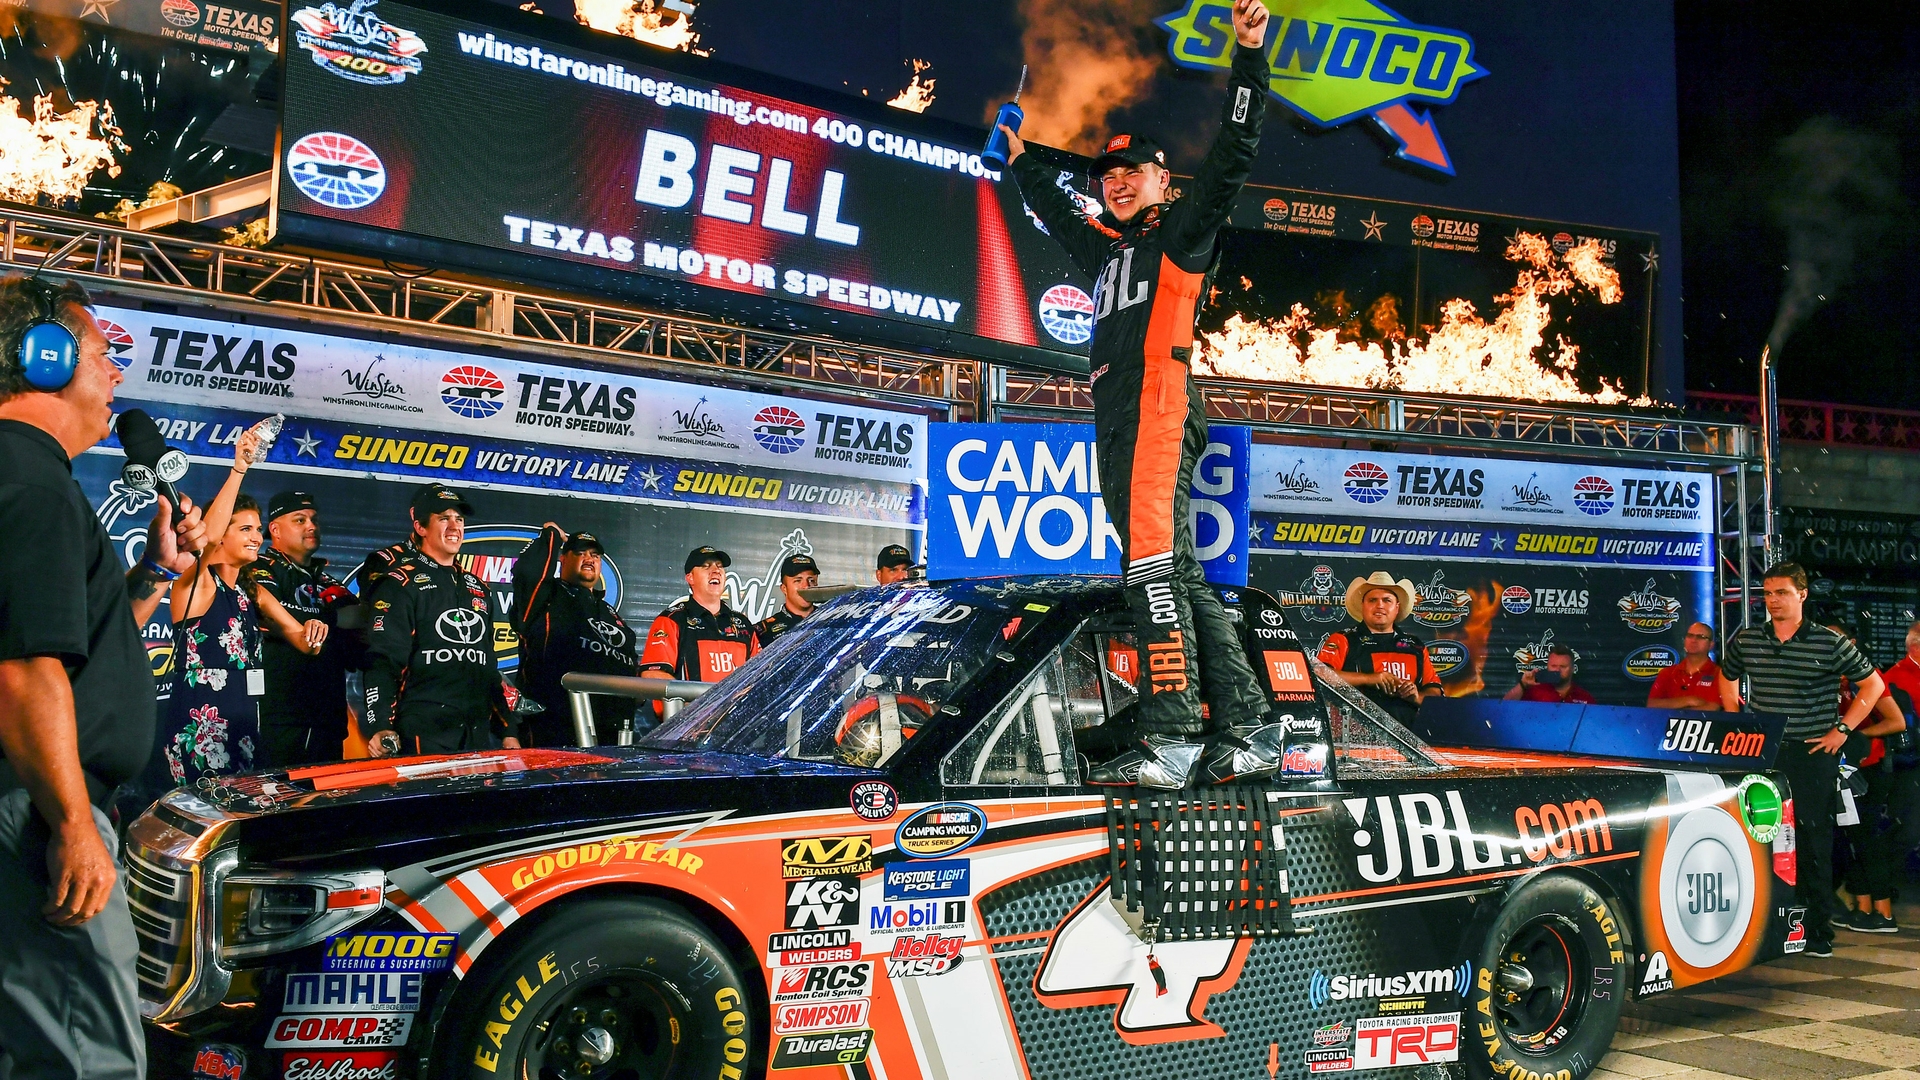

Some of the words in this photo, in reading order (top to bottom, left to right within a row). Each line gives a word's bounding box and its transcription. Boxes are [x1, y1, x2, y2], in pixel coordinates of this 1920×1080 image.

[204, 24, 230, 35] MOTOR
[205, 4, 274, 35] TEXAS
[161, 27, 173, 38] The
[174, 29, 197, 43] Great
[334, 55, 386, 74] 400
[458, 31, 807, 128] winstaronlinegaming.com
[813, 117, 863, 148] 400
[634, 128, 860, 246] BELL
[1291, 202, 1336, 220] TEXAS
[1273, 223, 1287, 231] Great
[1309, 218, 1333, 226] SPEEDWAY
[1437, 219, 1479, 236] TEXAS
[503, 214, 634, 263] TEXAS
[644, 242, 776, 290] MOTOR
[783, 269, 961, 324] SPEEDWAY
[149, 326, 297, 380] TEXAS
[147, 369, 204, 388] MOTOR
[208, 374, 290, 397] SPEEDWAY
[342, 360, 406, 397] WinStar
[516, 373, 637, 421] TEXAS
[515, 411, 563, 428] MOTOR
[565, 417, 631, 436] SPEEDWAY
[672, 402, 725, 437] WinStar
[815, 413, 914, 454] TEXAS
[161, 455, 182, 474] FOX
[335, 433, 469, 470] SUNOCO
[475, 451, 570, 479] VICTORY
[570, 460, 629, 484] LANE
[815, 447, 852, 462] MOTOR
[855, 450, 909, 468] SPEEDWAY
[127, 469, 149, 481] FOX
[1276, 463, 1320, 492] WinStar
[1397, 465, 1484, 498] TEXAS
[674, 470, 783, 501] SUNOCO
[787, 483, 864, 506] VICTORY
[865, 493, 912, 512] LANE
[1512, 477, 1552, 504] WinStar
[1622, 479, 1700, 508] TEXAS
[1397, 495, 1430, 506] MOTOR
[1432, 497, 1480, 509] SPEEDWAY
[1622, 508, 1652, 518] MOTOR
[1655, 509, 1698, 519] SPEEDWAY
[1273, 521, 1365, 544] SUNOCO
[1370, 528, 1438, 546] VICTORY
[1439, 531, 1481, 548] LANE
[1515, 532, 1598, 555] SUNOCO
[1603, 538, 1665, 556] VICTORY
[1665, 541, 1702, 557] LANE
[1281, 592, 1300, 606] NO
[1416, 584, 1455, 605] WinStar
[1534, 588, 1589, 608] TEXAS
[1633, 591, 1666, 611] WinStar
[1424, 613, 1451, 621] 400
[1638, 619, 1662, 627] 400
[1144, 581, 1190, 696] JBL.com
[1255, 628, 1299, 641] TOYOTA
[579, 636, 635, 666] TOYOTA
[1274, 662, 1303, 680] JBL
[1278, 693, 1315, 701] HARMAN
[1279, 714, 1322, 738] Rowdy
[1662, 719, 1765, 757] JBL.com
[1282, 751, 1323, 773] KBM
[855, 781, 889, 798] NASCAR
[857, 803, 894, 818] SALUTES
[938, 812, 970, 823] NASCAR
[904, 825, 946, 837] CAMPING
[946, 823, 977, 835] WORLD
[1342, 790, 1613, 882] JBL.com
[1747, 821, 1782, 843] ETHANOL
[783, 864, 839, 877] MECHANIX
[840, 860, 872, 873] WEAR
[888, 870, 935, 886] KEYSTONE
[936, 868, 967, 883] LIGHT
[904, 881, 952, 892] POLE
[1686, 872, 1730, 915] JBL
[790, 905, 840, 927] N
[870, 902, 937, 929] Mobil
[950, 903, 958, 923] 1
[1035, 806, 1253, 1045] 4
[931, 923, 965, 931] LUBRICANTS
[1584, 895, 1624, 964] EAGLE
[327, 935, 456, 958] MOOG
[773, 932, 846, 949] LINCOLN
[894, 934, 963, 958] Holley
[331, 959, 376, 969] STEERING
[380, 959, 385, 969] &
[390, 959, 448, 969] SUSPENSION
[788, 949, 853, 964] WELDERS
[888, 957, 953, 977] MSD
[804, 964, 869, 991] RCS
[1639, 980, 1673, 996] AXALTA
[286, 975, 420, 1004] MAHLE
[775, 992, 810, 1002] Renton
[812, 990, 830, 999] Coil
[832, 988, 863, 998] Spring
[474, 951, 560, 1073] EAGLE
[782, 1003, 862, 1028] SIMPSON
[1379, 1001, 1426, 1011] SCHROTH
[274, 1018, 377, 1041] COMP
[1359, 1020, 1384, 1028] TOYOTA
[1387, 1018, 1411, 1026] RACING
[1414, 1014, 1459, 1024] DEVELOPMENT
[343, 1035, 393, 1045] CAMS
[1314, 1027, 1351, 1037] INTERSTATE
[786, 1033, 866, 1055] Duralast
[1358, 1024, 1458, 1065] TRD
[193, 1050, 241, 1080] KBM
[837, 1049, 864, 1062] GT
[1308, 1052, 1346, 1062] LINCOLN
[1315, 1062, 1349, 1070] WELDERS
[283, 1058, 396, 1080] Edelbrock
